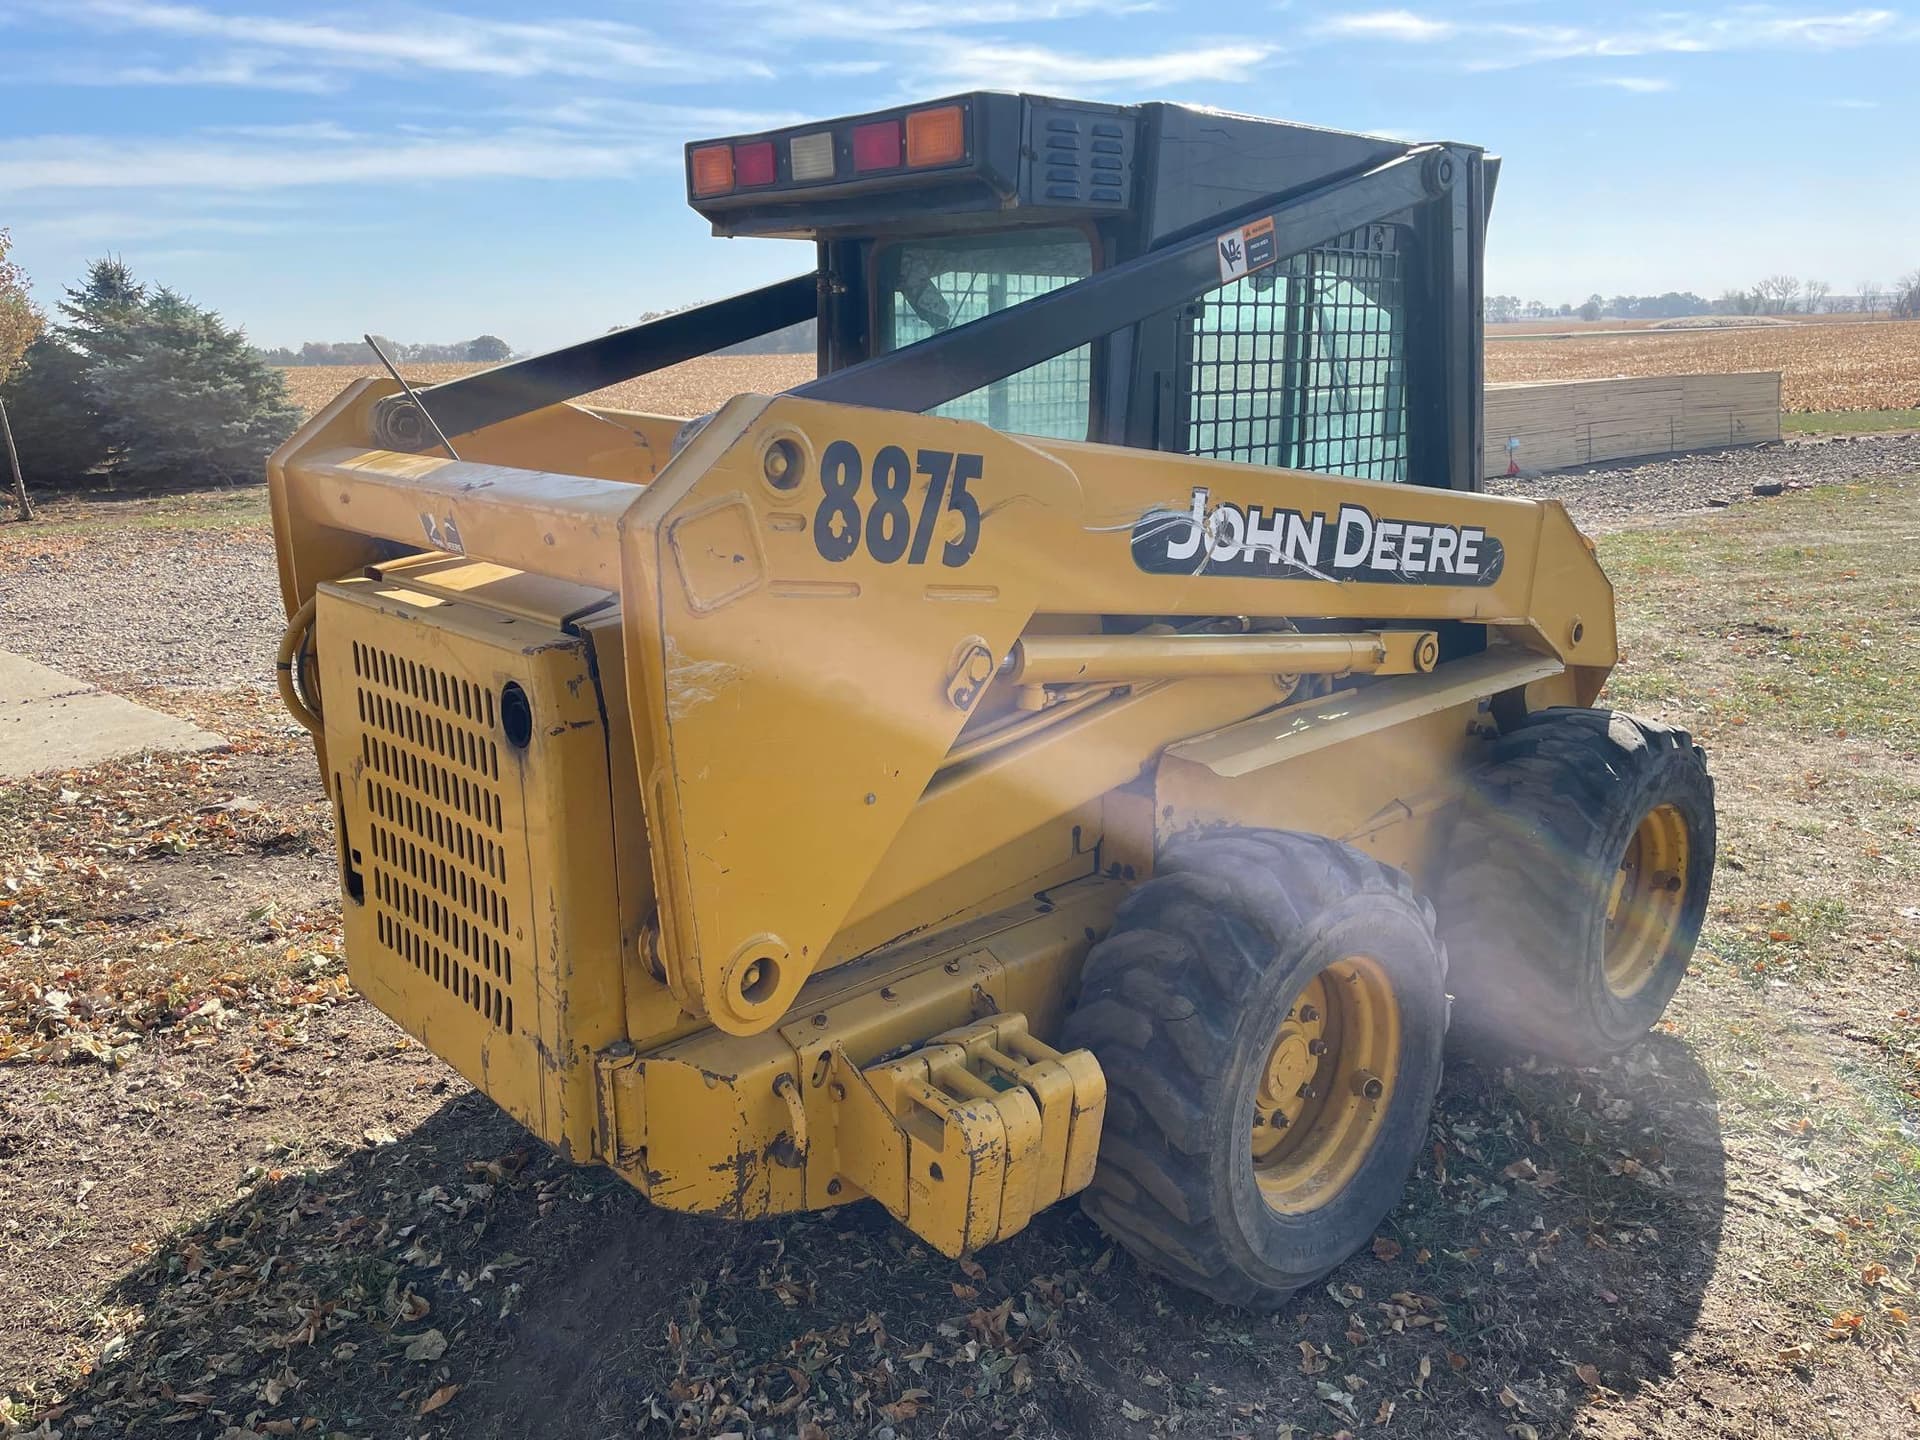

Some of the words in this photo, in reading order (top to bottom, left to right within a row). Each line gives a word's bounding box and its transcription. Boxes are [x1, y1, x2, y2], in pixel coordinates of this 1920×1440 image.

[814, 440, 983, 568] 8875
[1167, 488, 1323, 566] JOHN
[1334, 506, 1484, 574] DEERE
